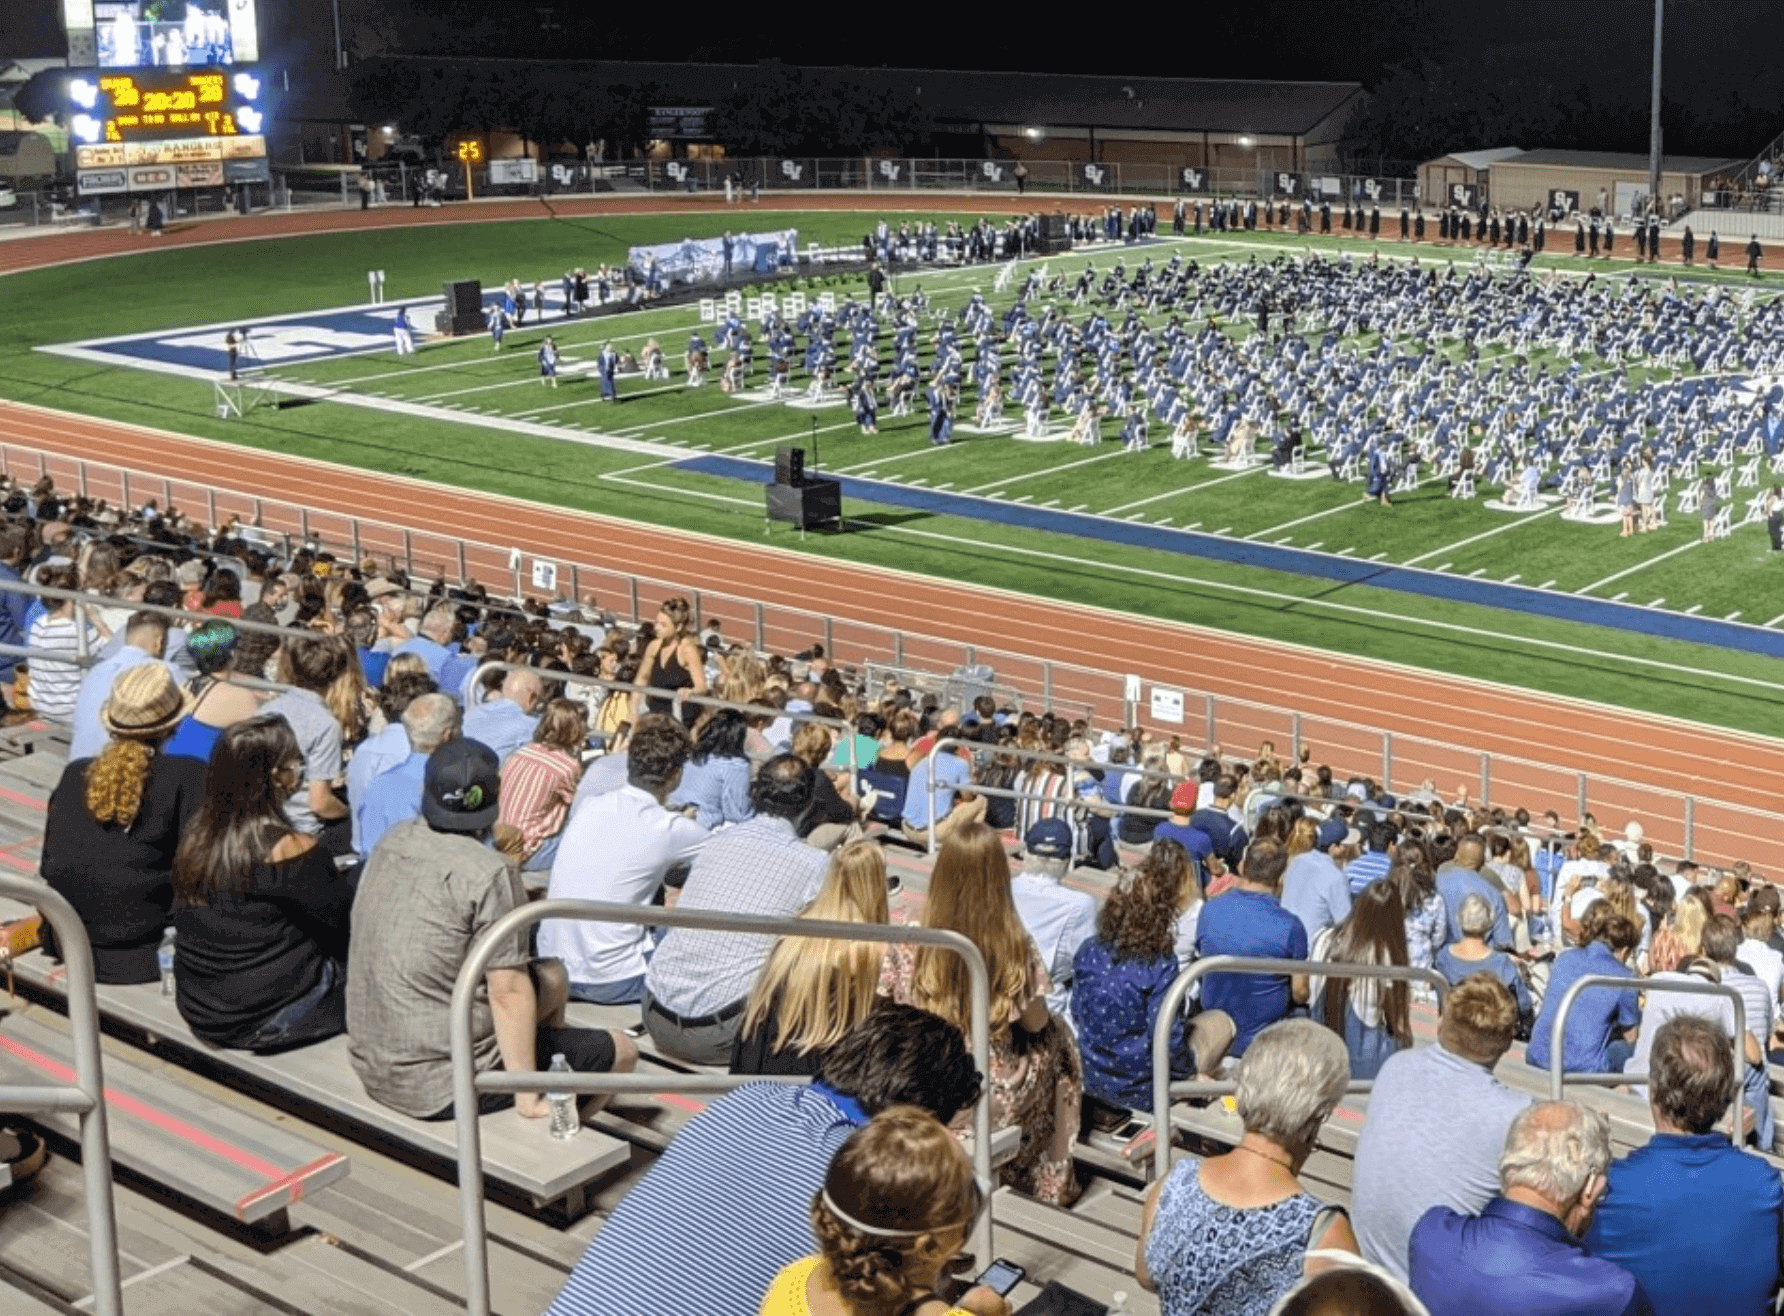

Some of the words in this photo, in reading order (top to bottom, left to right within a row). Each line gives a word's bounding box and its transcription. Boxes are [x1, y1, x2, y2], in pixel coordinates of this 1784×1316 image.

[458, 141, 480, 160] 25
[553, 164, 574, 185] SV
[666, 162, 688, 182] SV
[782, 159, 802, 180] SV
[880, 160, 900, 180] SV
[983, 161, 1002, 181] SV
[1085, 165, 1104, 184] SV
[1184, 168, 1202, 188] SV
[1279, 173, 1296, 193] SV
[1364, 179, 1382, 199] SV
[1453, 184, 1471, 206] SV
[1554, 191, 1573, 212] SV
